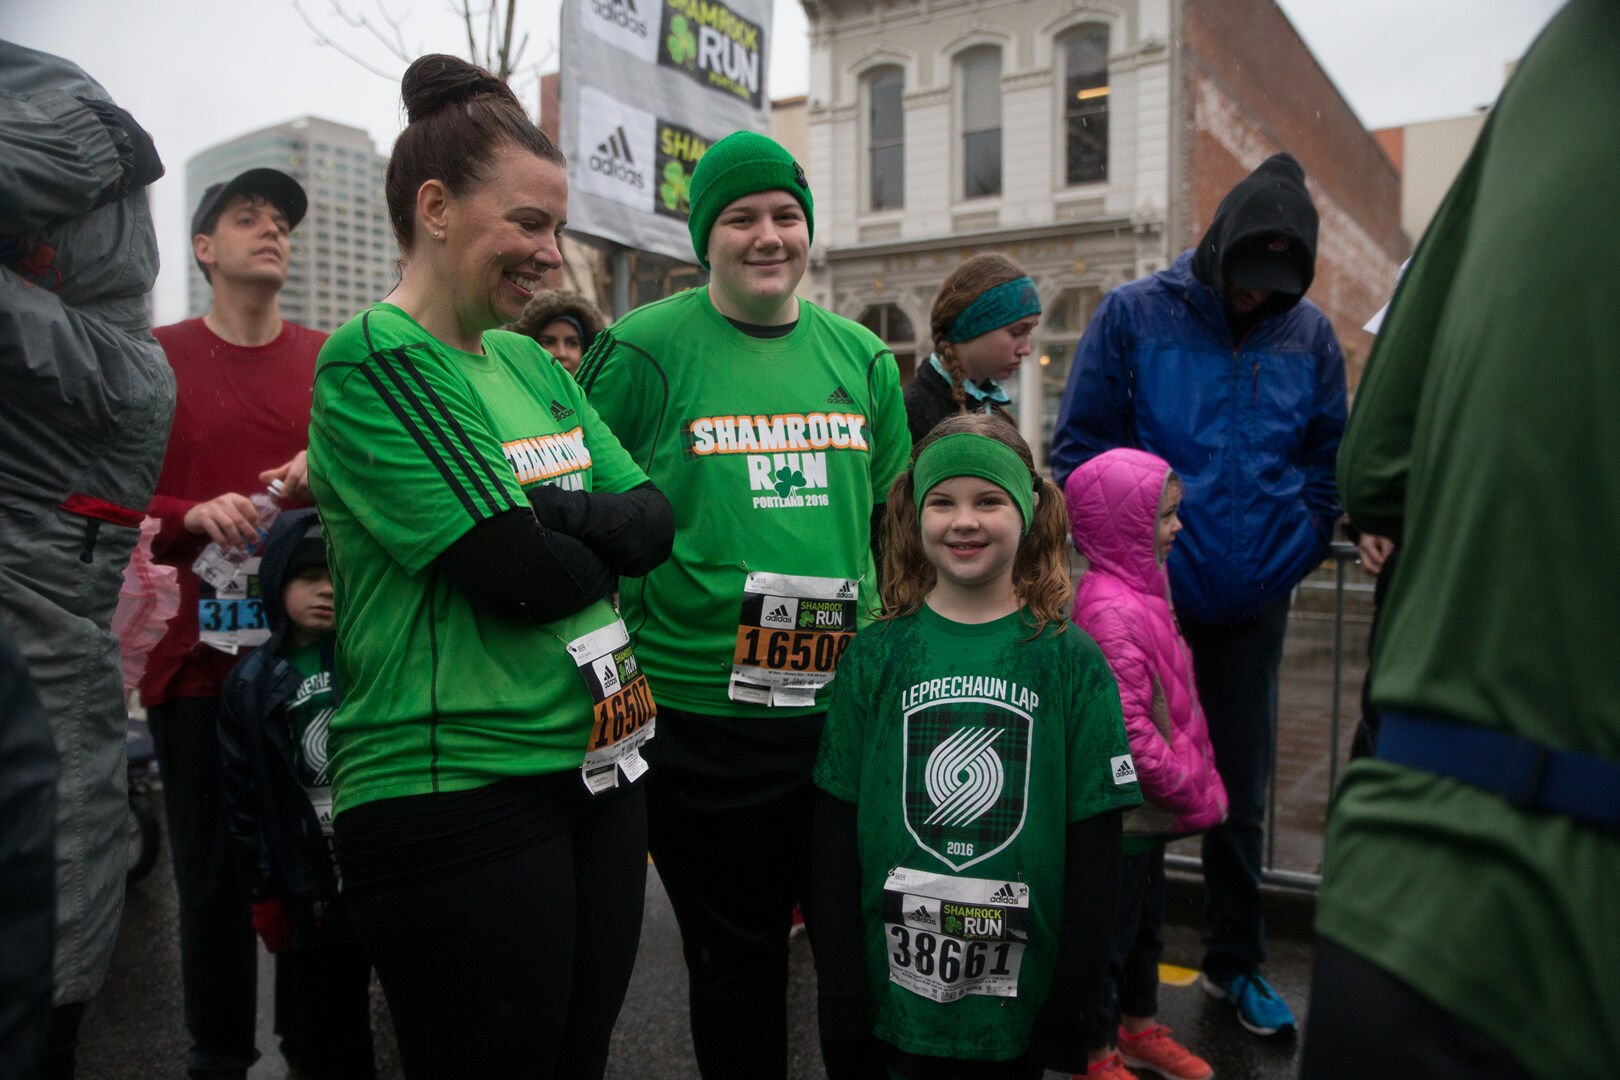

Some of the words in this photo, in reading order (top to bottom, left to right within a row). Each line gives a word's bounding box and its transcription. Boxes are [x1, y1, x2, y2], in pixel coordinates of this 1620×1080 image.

[592, 0, 647, 38] adidas
[699, 25, 759, 93] RUN
[590, 156, 644, 189] adidas
[693, 414, 868, 453] SHAMROCK
[747, 452, 828, 491] RUN
[752, 495, 804, 509] PORTLAND
[806, 494, 829, 507] 2016
[836, 591, 854, 599] adidas
[800, 601, 844, 612] SHAMROCK
[765, 613, 792, 624] adidas
[815, 610, 843, 626] RUN
[624, 654, 637, 677] RUN
[902, 675, 1008, 711] LEPRECHAUN
[1011, 682, 1039, 713] LAP
[594, 677, 651, 749] 16507
[1115, 769, 1134, 778] adidas
[947, 841, 974, 856] 2016
[894, 873, 907, 881] BEER
[990, 896, 1018, 905] adidas
[908, 914, 936, 926] adidas
[943, 904, 1002, 920] SHAMROCK
[964, 917, 1002, 936] RUN
[891, 926, 1010, 983] 38661
